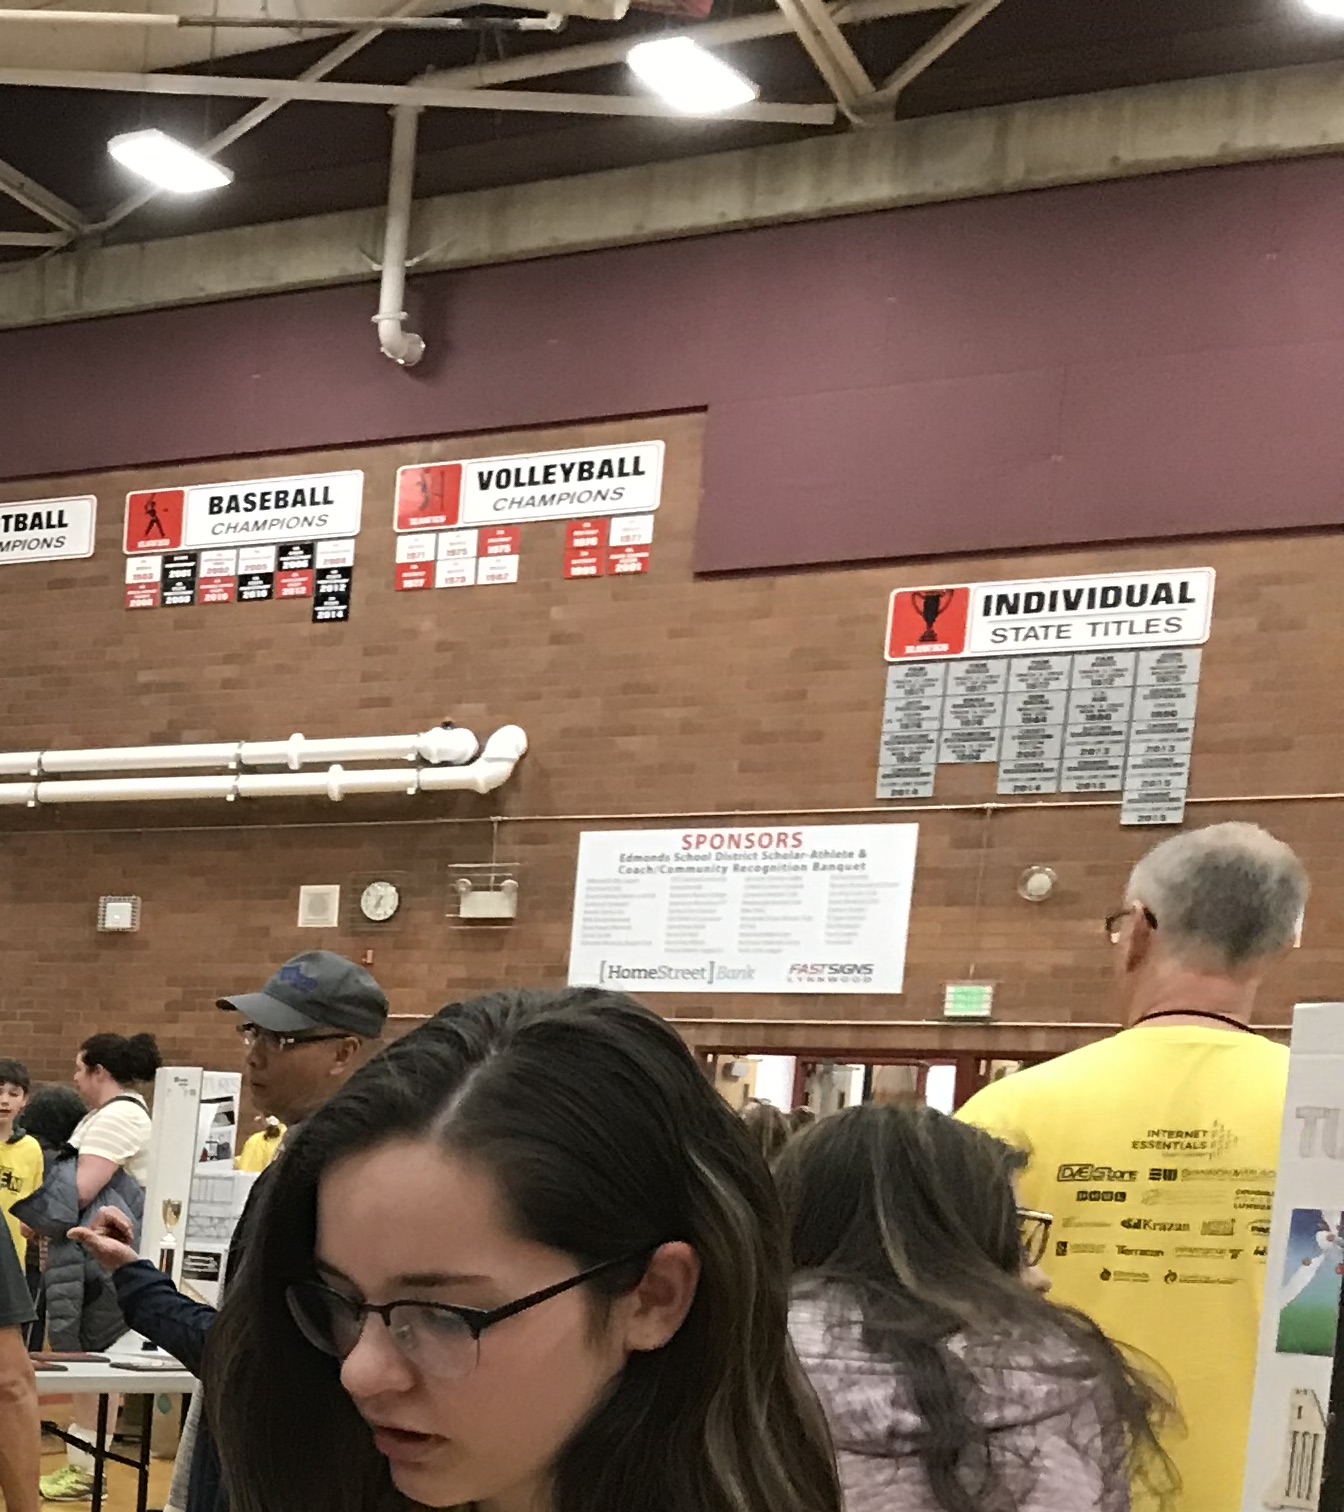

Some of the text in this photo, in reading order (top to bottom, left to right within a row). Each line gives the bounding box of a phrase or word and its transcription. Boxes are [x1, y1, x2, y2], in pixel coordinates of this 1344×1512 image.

[477, 455, 646, 491] VOLLEYBALL
[208, 485, 335, 516] BASEBALL
[492, 486, 626, 512] CHAMPIONS
[210, 512, 330, 537] CHAMPIONS
[982, 581, 1196, 617] INDIVIDUAL
[991, 616, 1184, 645] STATE TITLES
[681, 831, 804, 851] SPONSORS
[674, 852, 712, 862] School
[715, 851, 758, 862] District
[732, 863, 808, 875] Recognition
[812, 861, 866, 872] Banquet
[1131, 1140, 1208, 1151] ESSENTIALS
